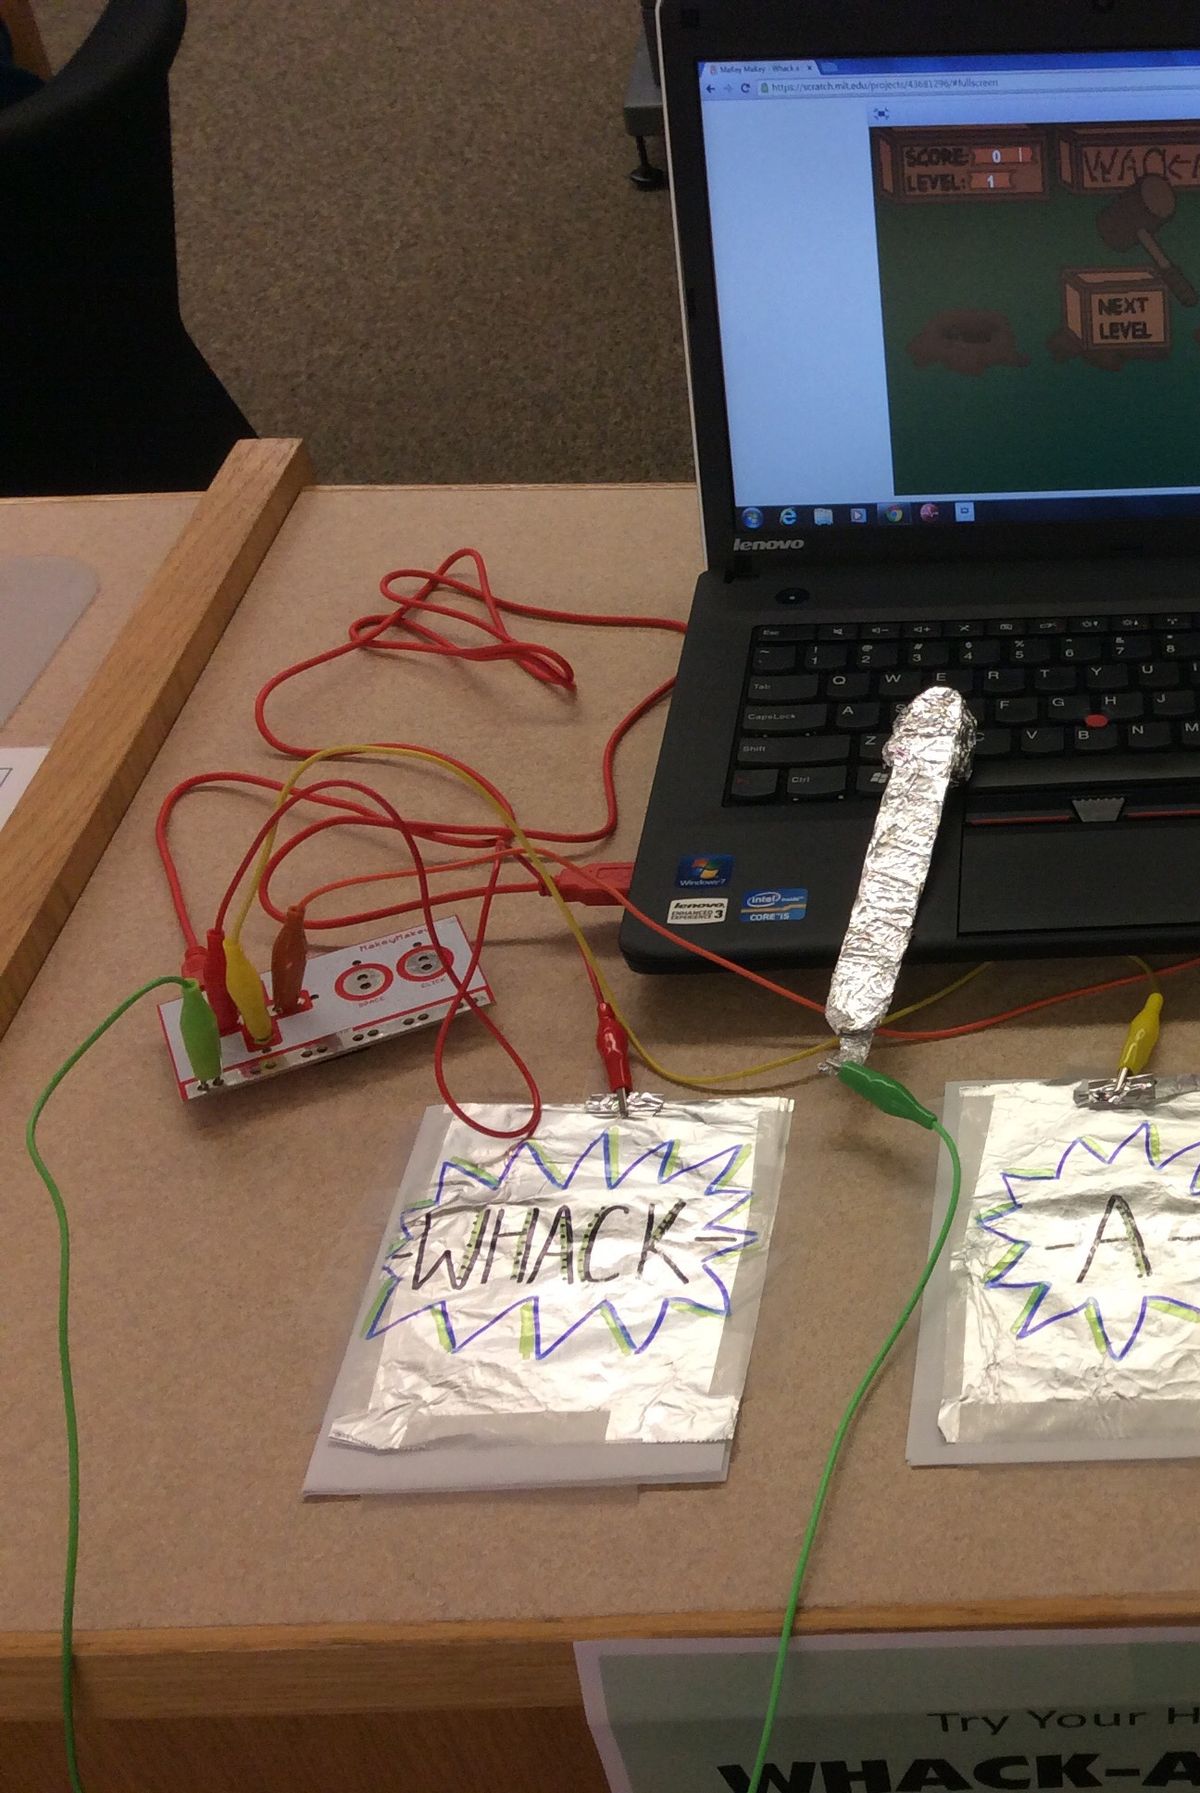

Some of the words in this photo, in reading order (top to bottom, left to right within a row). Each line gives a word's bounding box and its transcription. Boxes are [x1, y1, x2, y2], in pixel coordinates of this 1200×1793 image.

[991, 149, 1001, 163] 0
[986, 174, 996, 189] 1
[1098, 297, 1149, 316] NEXT
[1099, 321, 1152, 340] LEVEL
[733, 538, 805, 551] lenovo
[832, 675, 847, 685] Q
[884, 674, 902, 683] W
[935, 672, 947, 681] E
[987, 670, 1000, 680] R
[1039, 669, 1050, 678] T
[1090, 667, 1102, 676] Y
[1141, 664, 1154, 674] U
[841, 705, 855, 715] A
[999, 700, 1011, 709] F
[1051, 697, 1066, 707] G
[1104, 695, 1117, 705] H
[1155, 693, 1167, 703] J
[864, 735, 877, 745] Z
[1026, 730, 1039, 740] V
[1077, 729, 1090, 740] B
[1131, 724, 1144, 735] N
[1184, 721, 1199, 732] M
[790, 775, 812, 784] Ctrl
[673, 902, 724, 910] lenovo
[713, 910, 724, 920] 3
[359, 927, 428, 952] MakeyMake
[927, 1711, 1009, 1736] Try
[1026, 1709, 1148, 1729] Your
